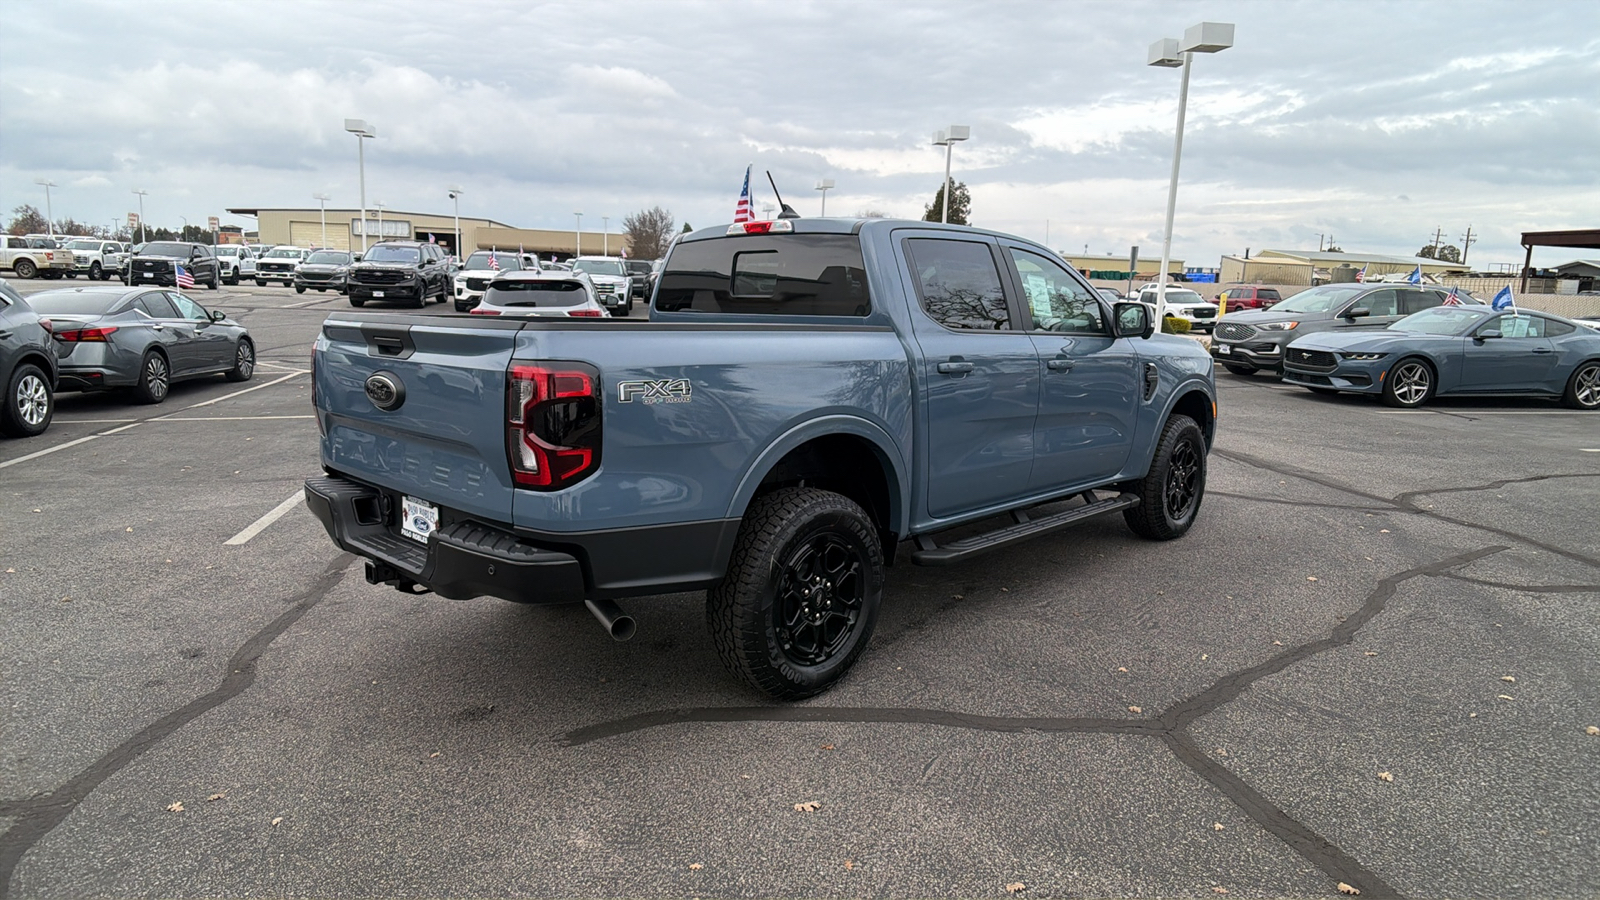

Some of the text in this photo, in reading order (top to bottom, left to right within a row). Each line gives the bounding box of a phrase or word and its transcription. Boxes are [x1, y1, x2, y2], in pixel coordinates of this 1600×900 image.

[617, 379, 692, 403] FX4
[666, 396, 691, 404] ROAD
[401, 528, 412, 538] PASO
[845, 517, 880, 587] WRANGLER
